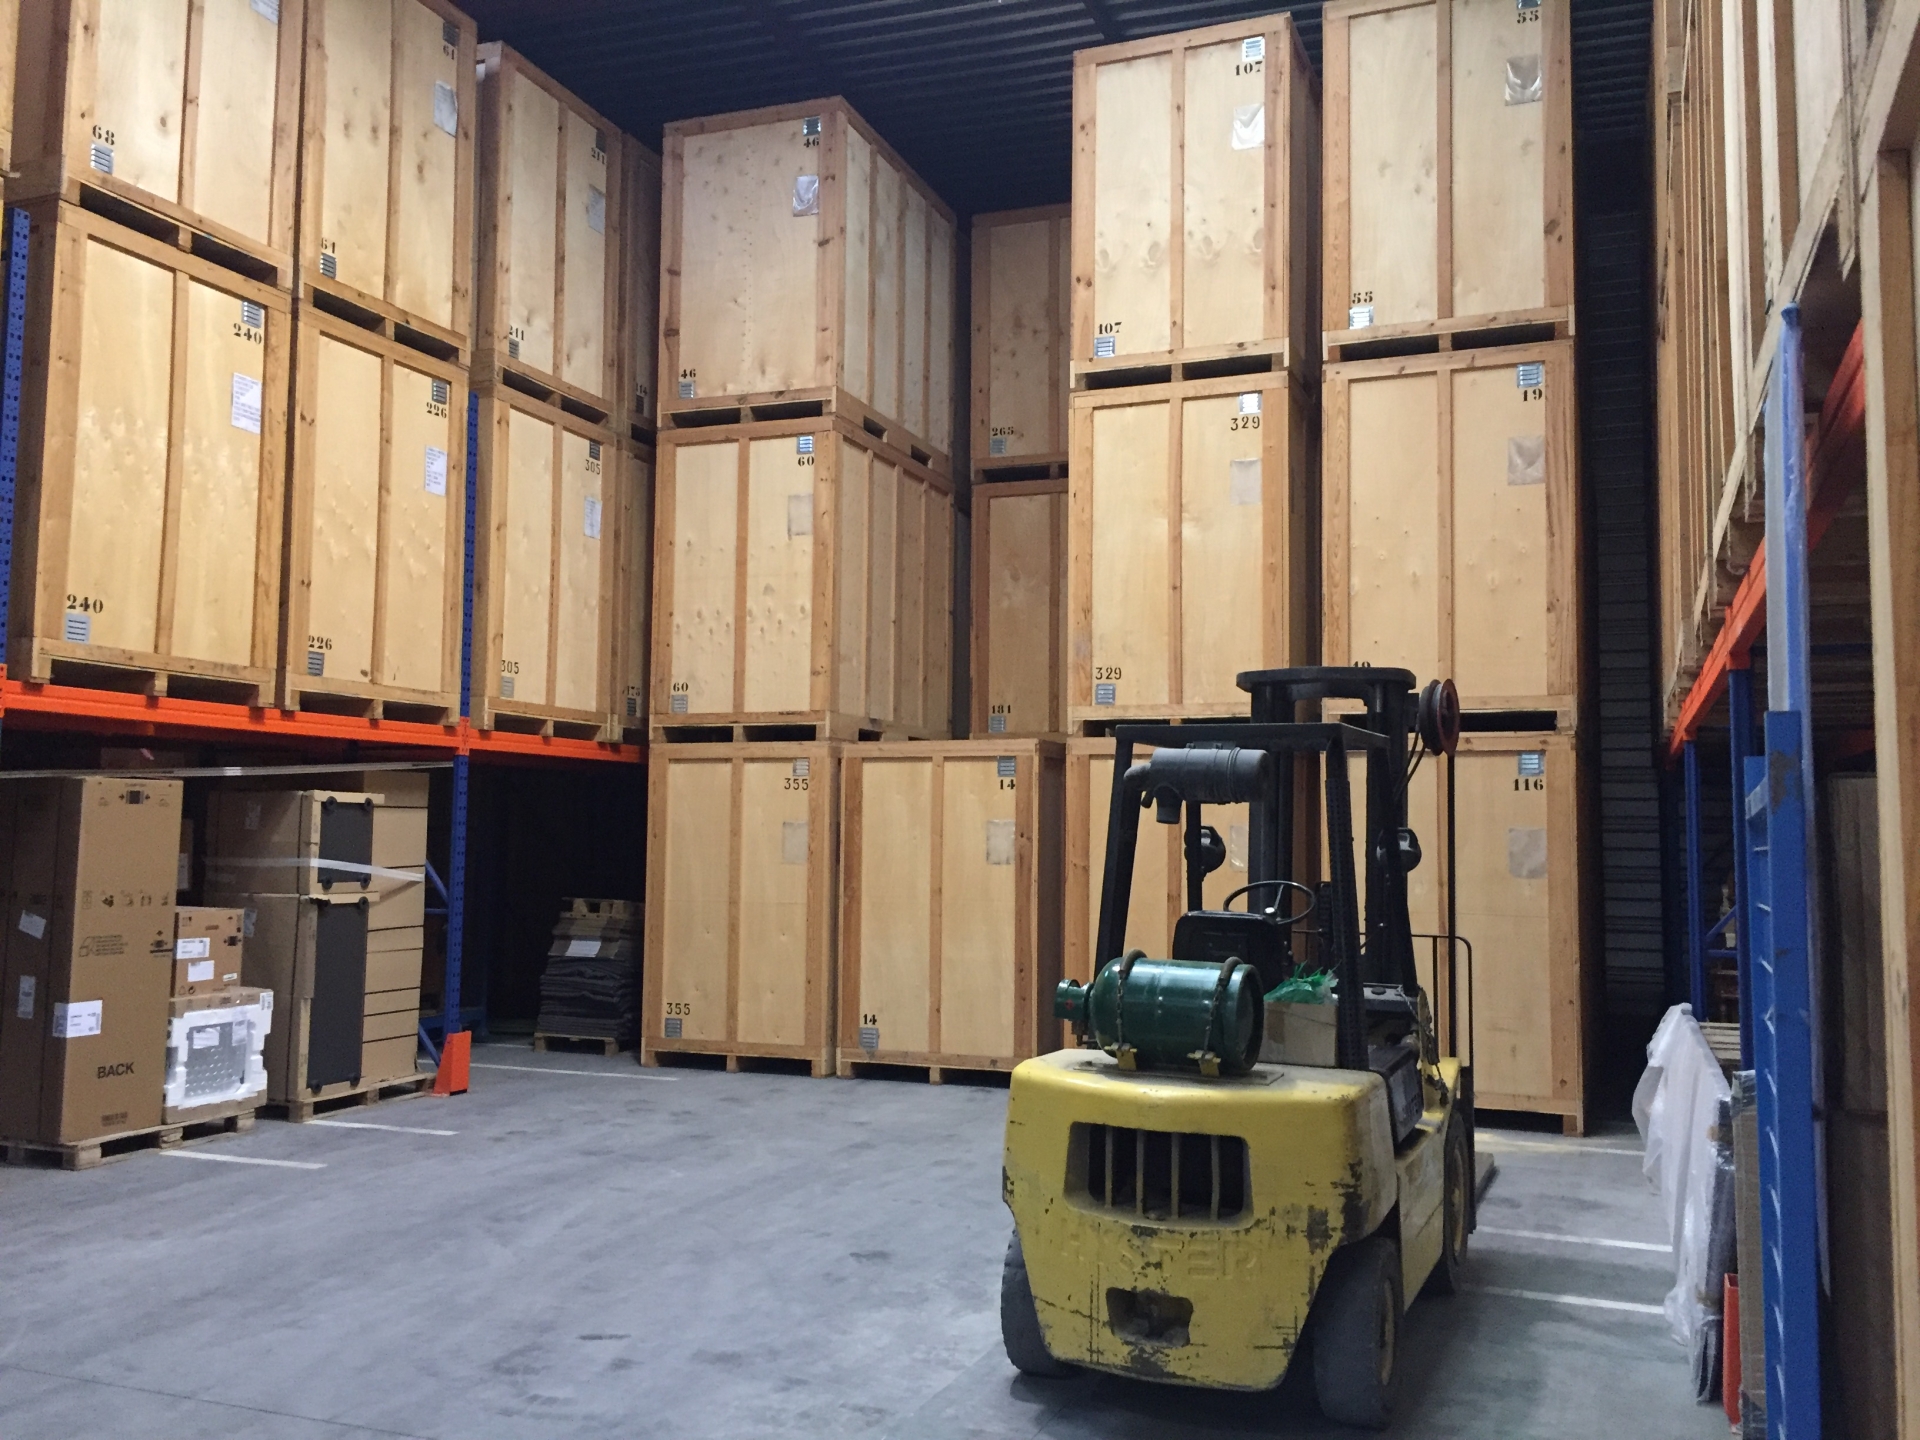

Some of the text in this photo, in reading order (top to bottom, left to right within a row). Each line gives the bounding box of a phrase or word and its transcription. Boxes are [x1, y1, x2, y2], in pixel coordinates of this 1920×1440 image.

[1517, 10, 1539, 24] 55
[1235, 60, 1263, 76] 107
[92, 125, 115, 145] 68
[803, 137, 819, 148] 46
[321, 238, 336, 254] 61
[1352, 291, 1373, 304] 55
[233, 323, 262, 345] 240
[1098, 322, 1122, 335] 107
[681, 369, 696, 379] 46
[1523, 388, 1543, 402] 19
[426, 402, 447, 418] 226
[1230, 416, 1261, 431] 329
[991, 426, 1015, 437] 265
[585, 459, 601, 475] 305
[797, 456, 815, 467] 60
[66, 594, 104, 614] 240
[308, 634, 333, 651] 226
[501, 659, 520, 674] 305
[1095, 667, 1122, 680] 329
[672, 682, 689, 692] 60
[991, 704, 1012, 714] 181
[784, 777, 809, 791] 355
[1000, 779, 1015, 790] 14
[1513, 778, 1544, 791] 116
[666, 1002, 691, 1016] 355
[862, 1013, 878, 1026] 14
[97, 1061, 135, 1079] BACK
